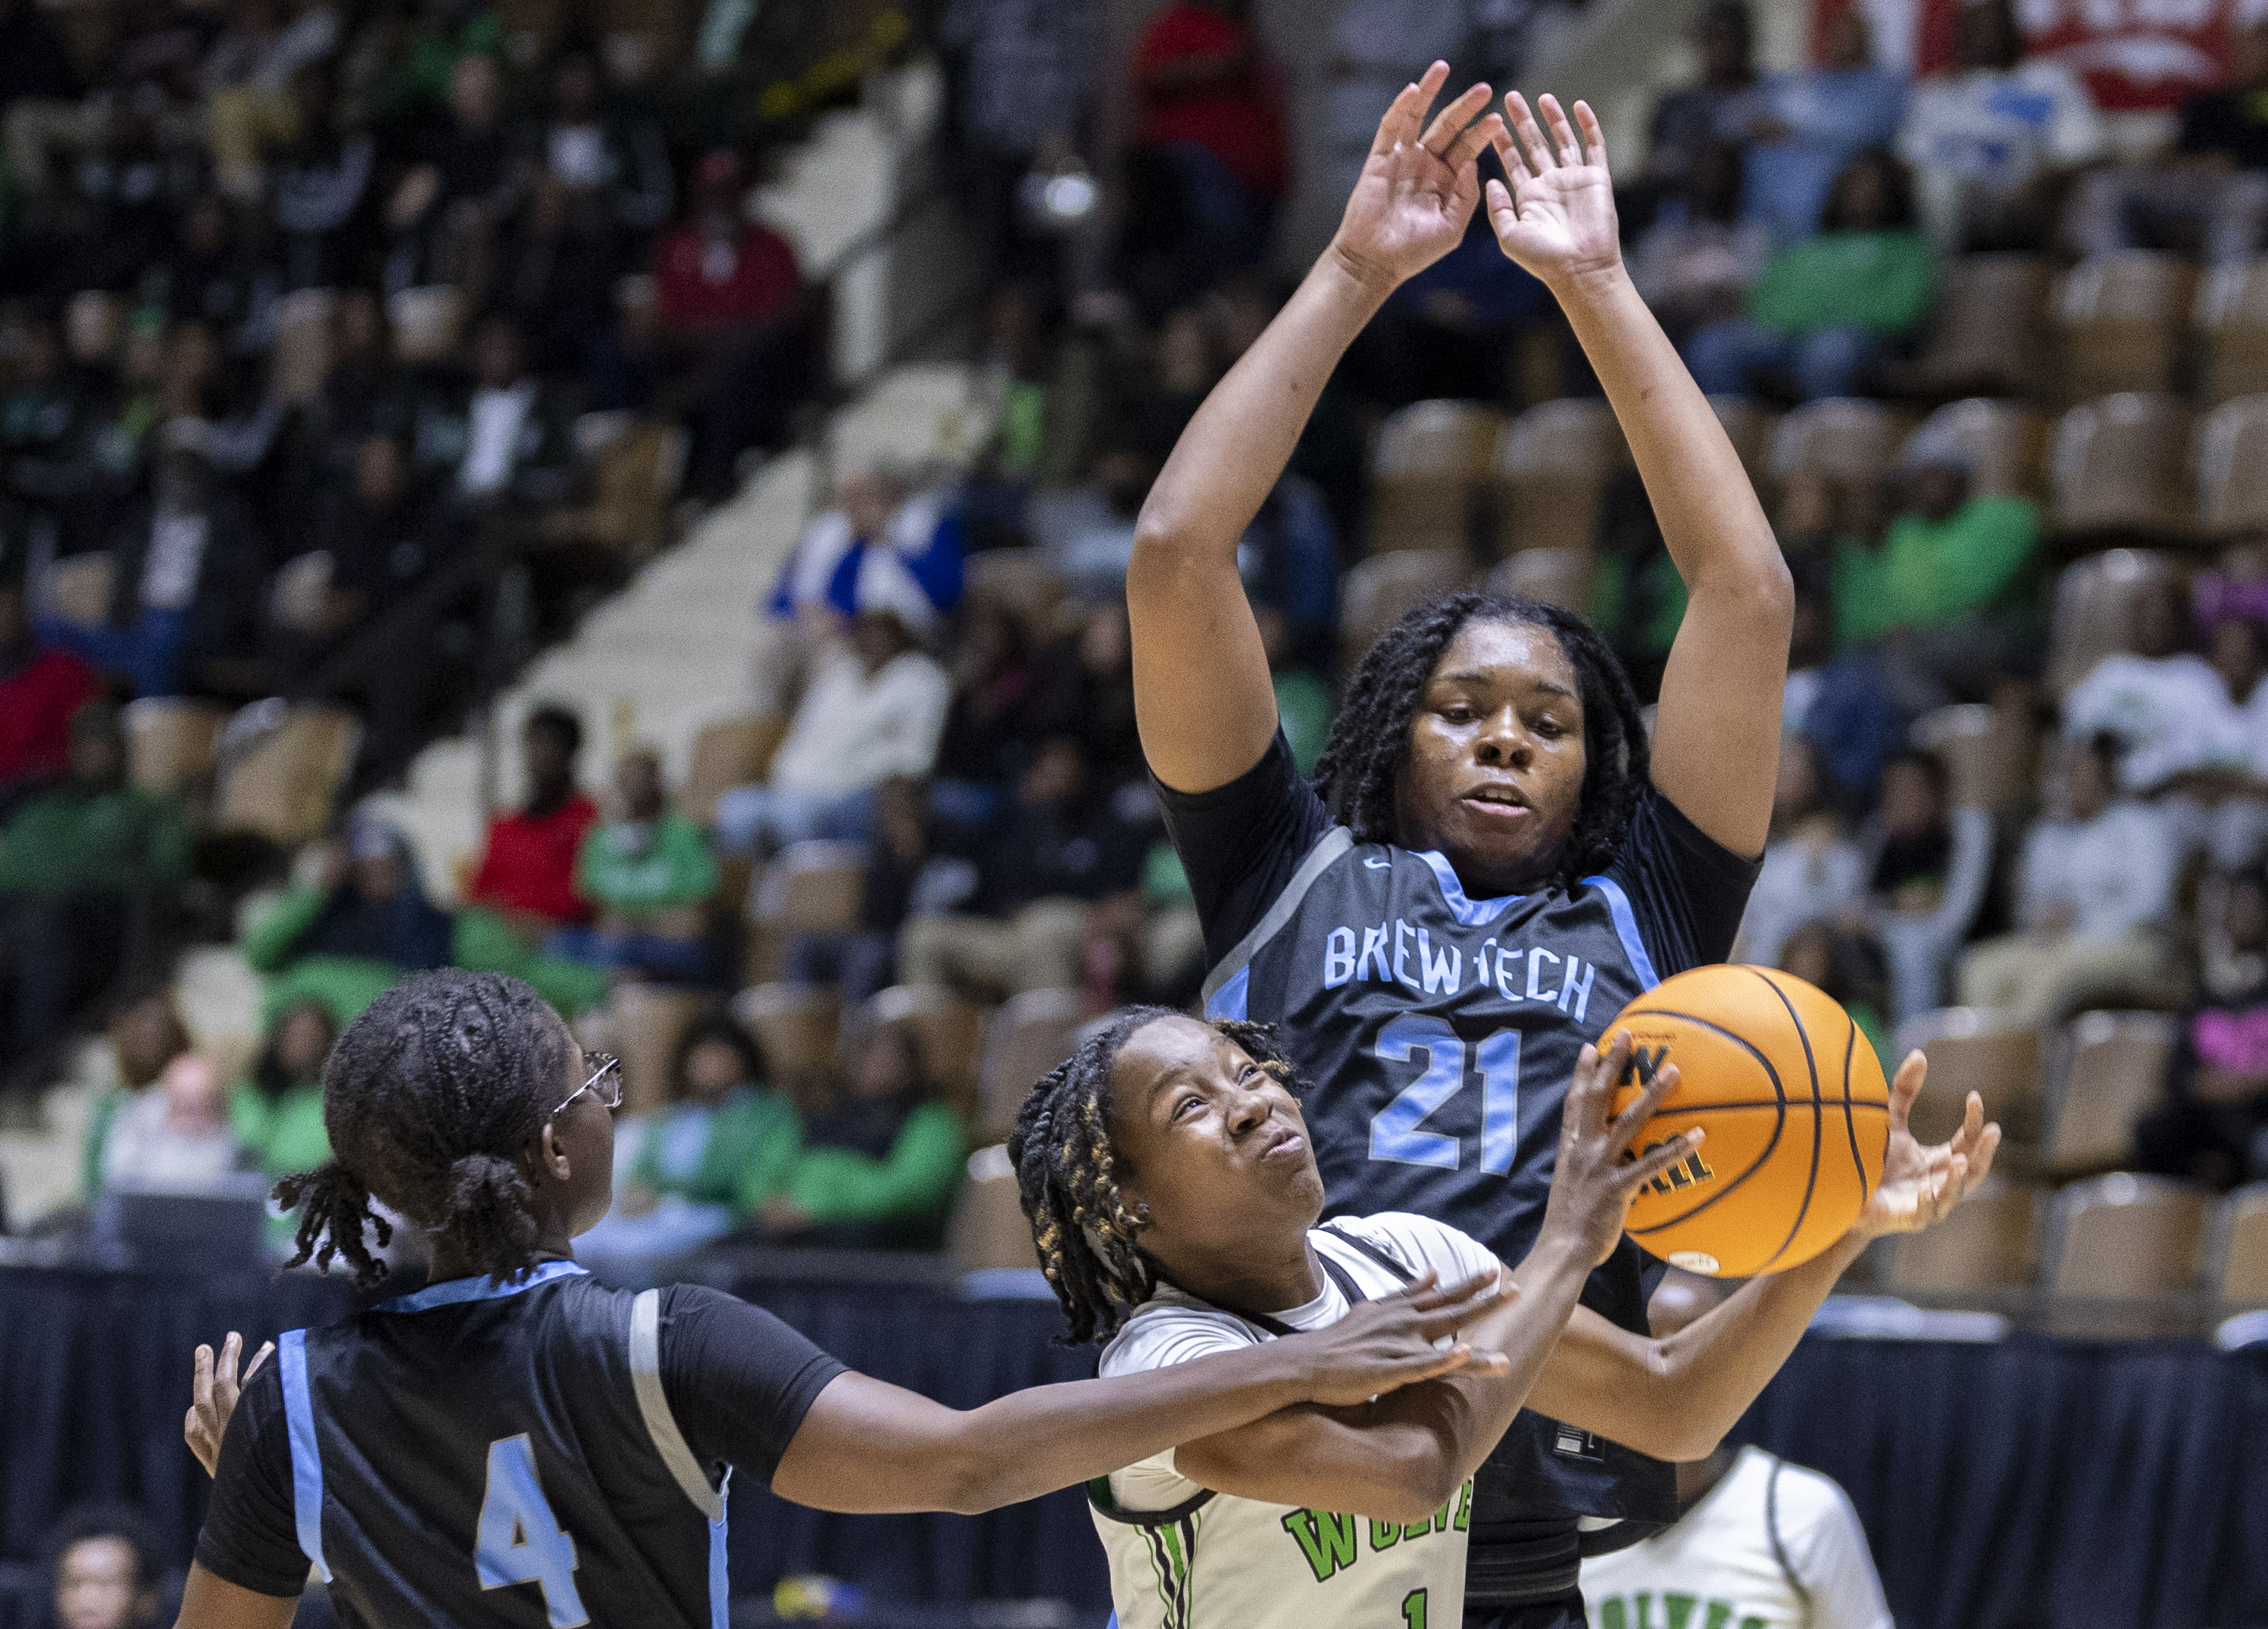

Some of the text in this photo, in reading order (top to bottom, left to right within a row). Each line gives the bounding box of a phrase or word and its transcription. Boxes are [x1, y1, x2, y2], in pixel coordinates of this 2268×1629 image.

[1324, 917, 1462, 996] BREW
[1368, 1010, 1522, 1178] 21
[473, 1431, 591, 1629] 4
